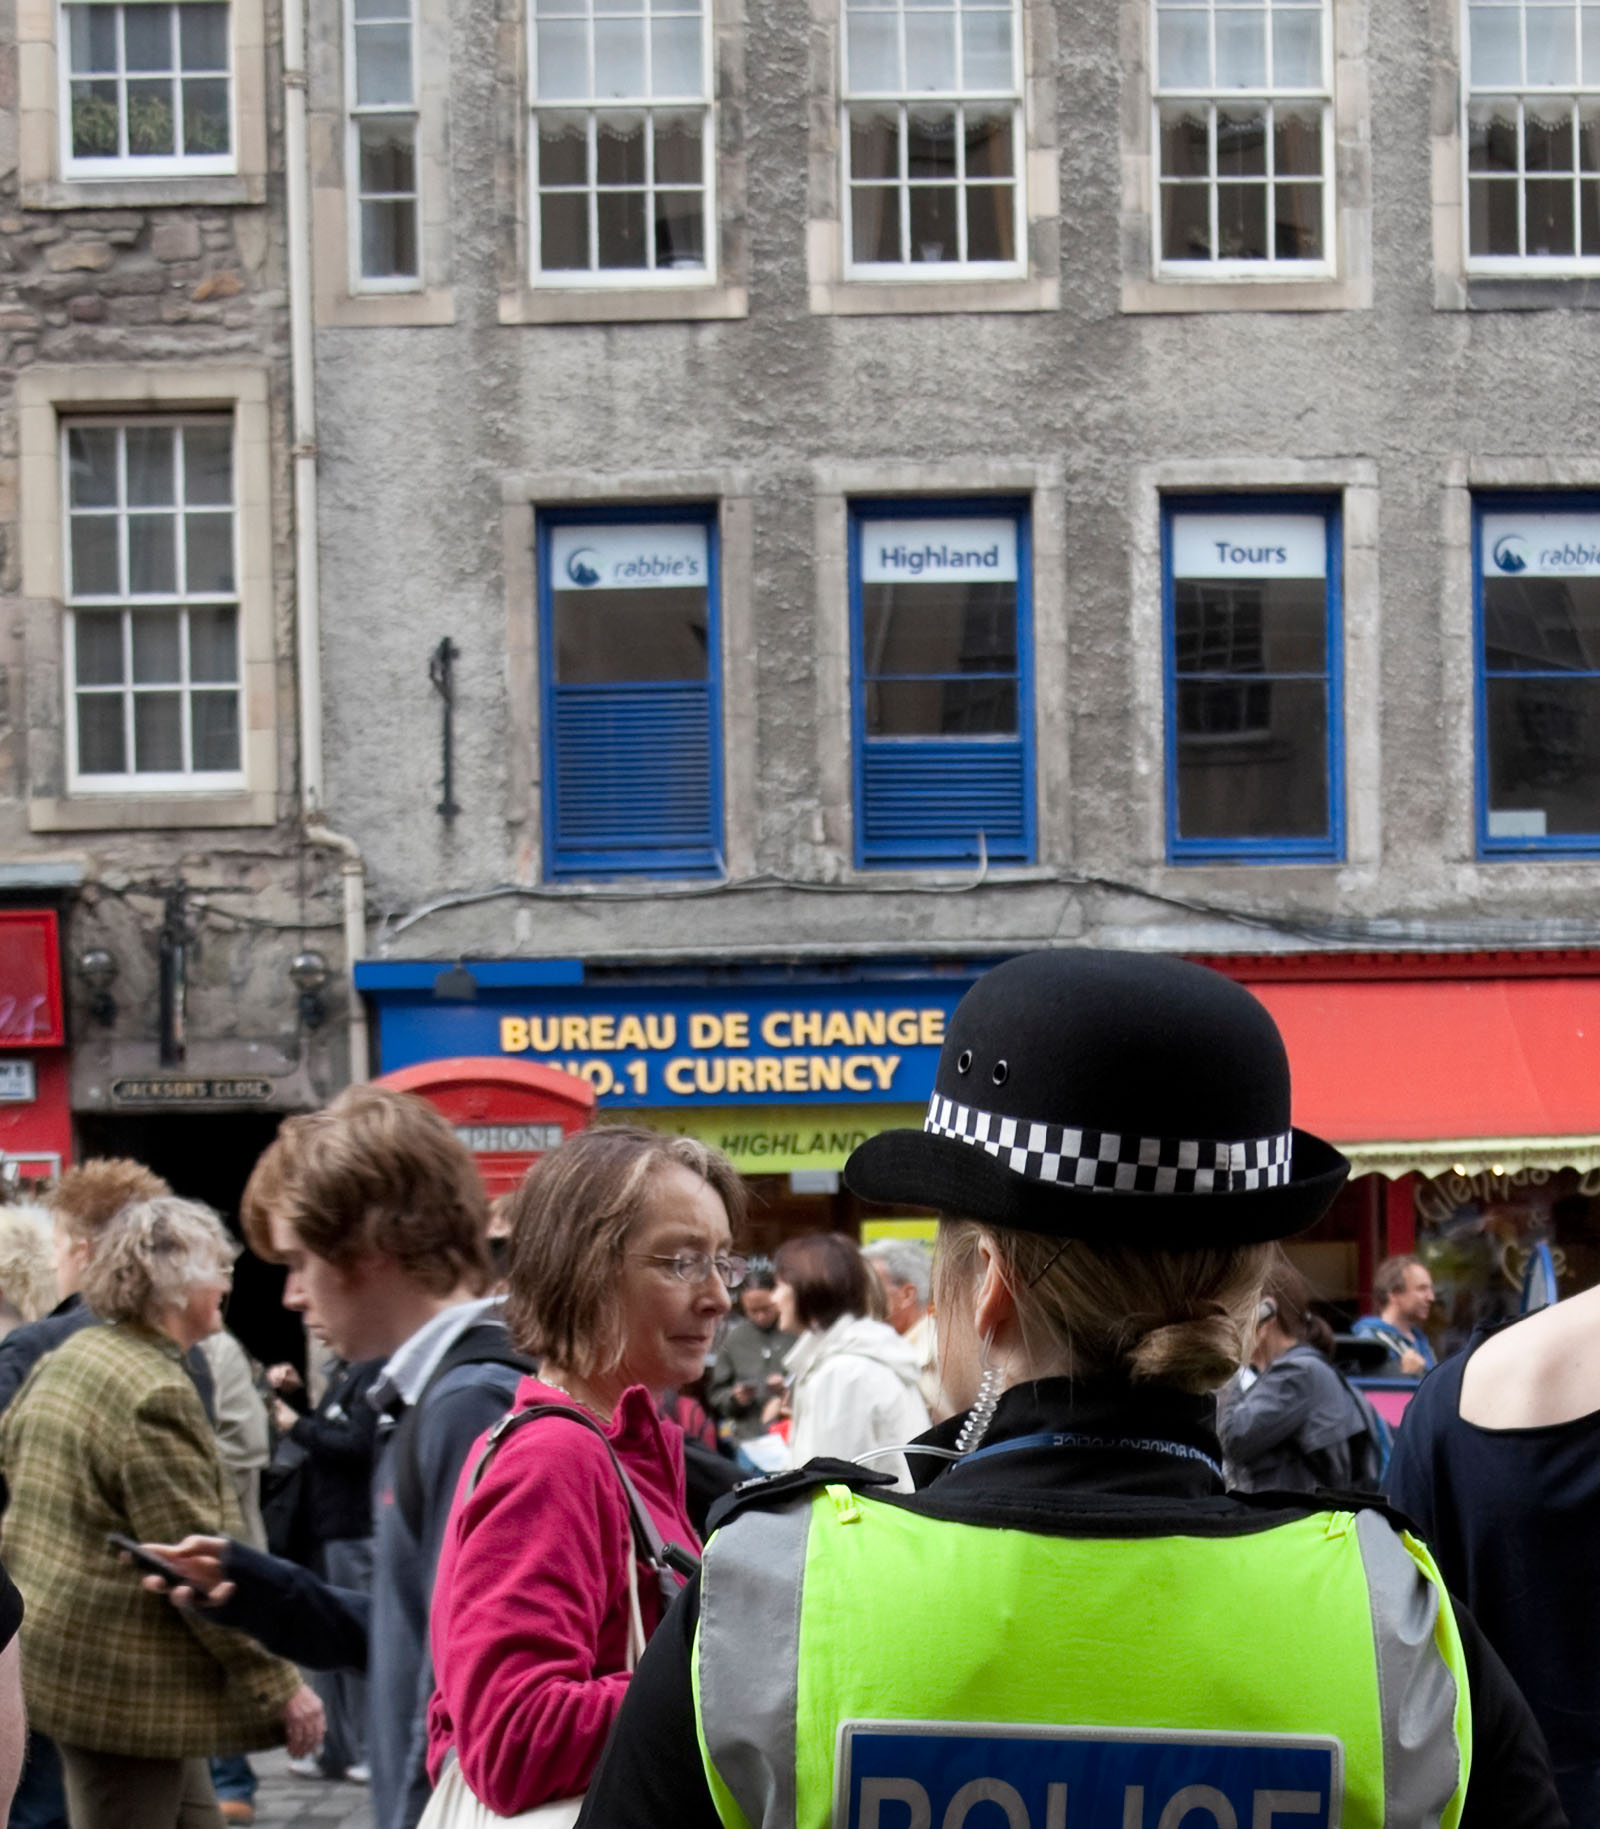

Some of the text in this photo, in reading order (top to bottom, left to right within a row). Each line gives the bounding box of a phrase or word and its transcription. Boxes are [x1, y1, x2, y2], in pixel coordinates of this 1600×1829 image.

[614, 552, 699, 577] rabbie's
[881, 545, 999, 574] Highland
[1215, 542, 1287, 564] Tours
[501, 1008, 945, 1052] BUREAU DE CHANGE
[665, 1054, 901, 1095] CURRENCY
